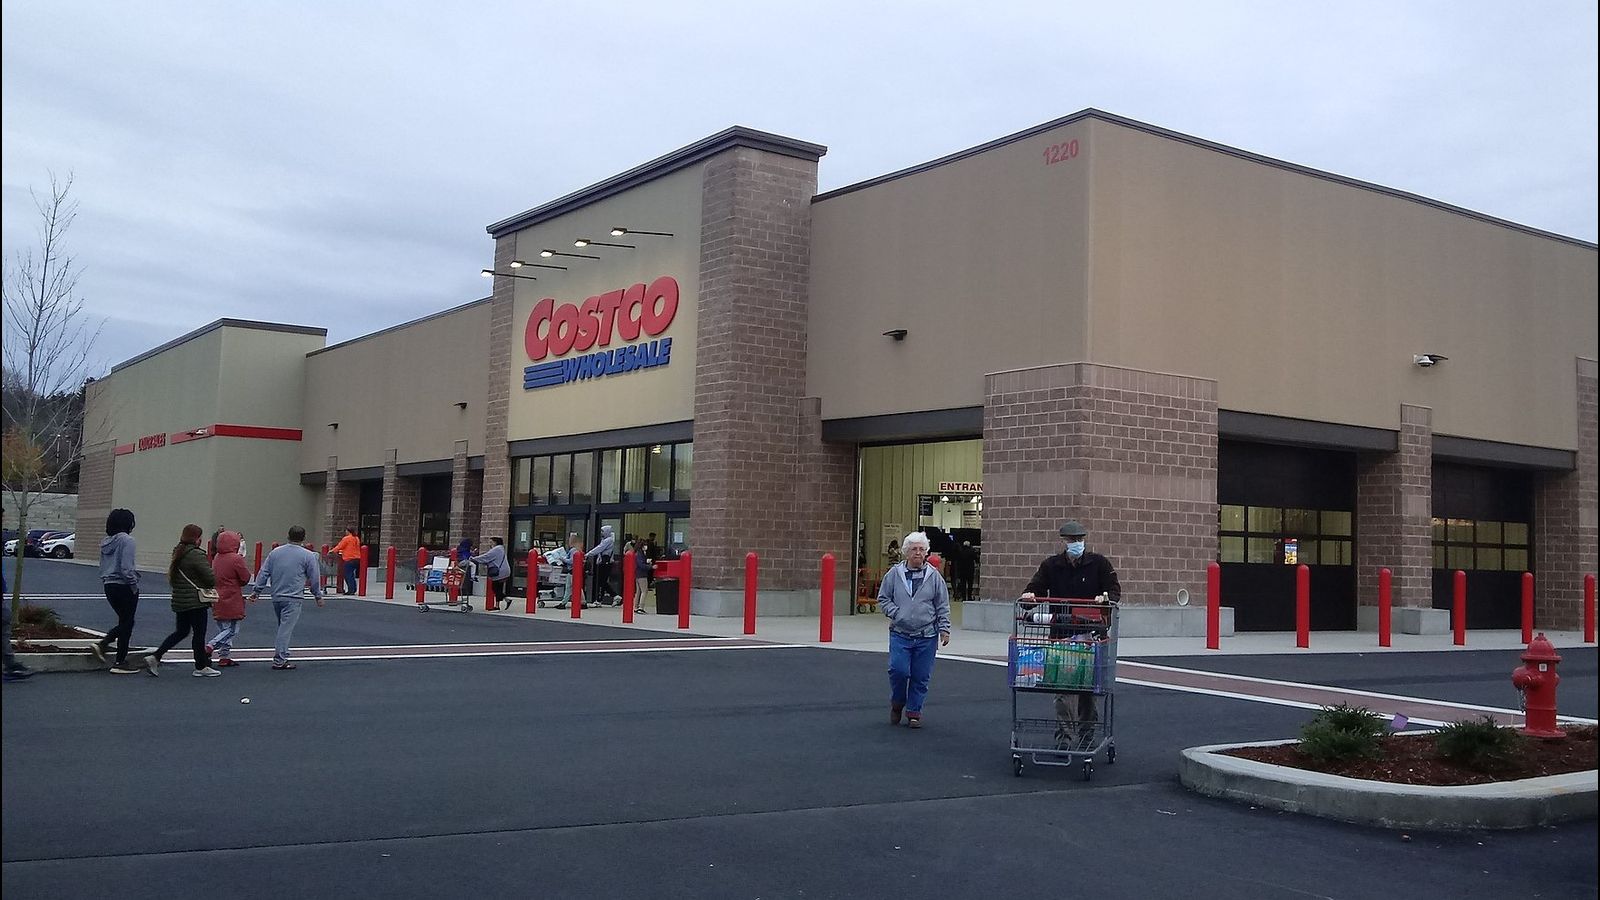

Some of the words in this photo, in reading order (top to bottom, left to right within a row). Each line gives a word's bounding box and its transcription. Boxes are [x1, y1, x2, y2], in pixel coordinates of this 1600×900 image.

[1042, 139, 1079, 165] 1220
[524, 276, 679, 361] COSTCO
[562, 337, 672, 383] WHOLESALE
